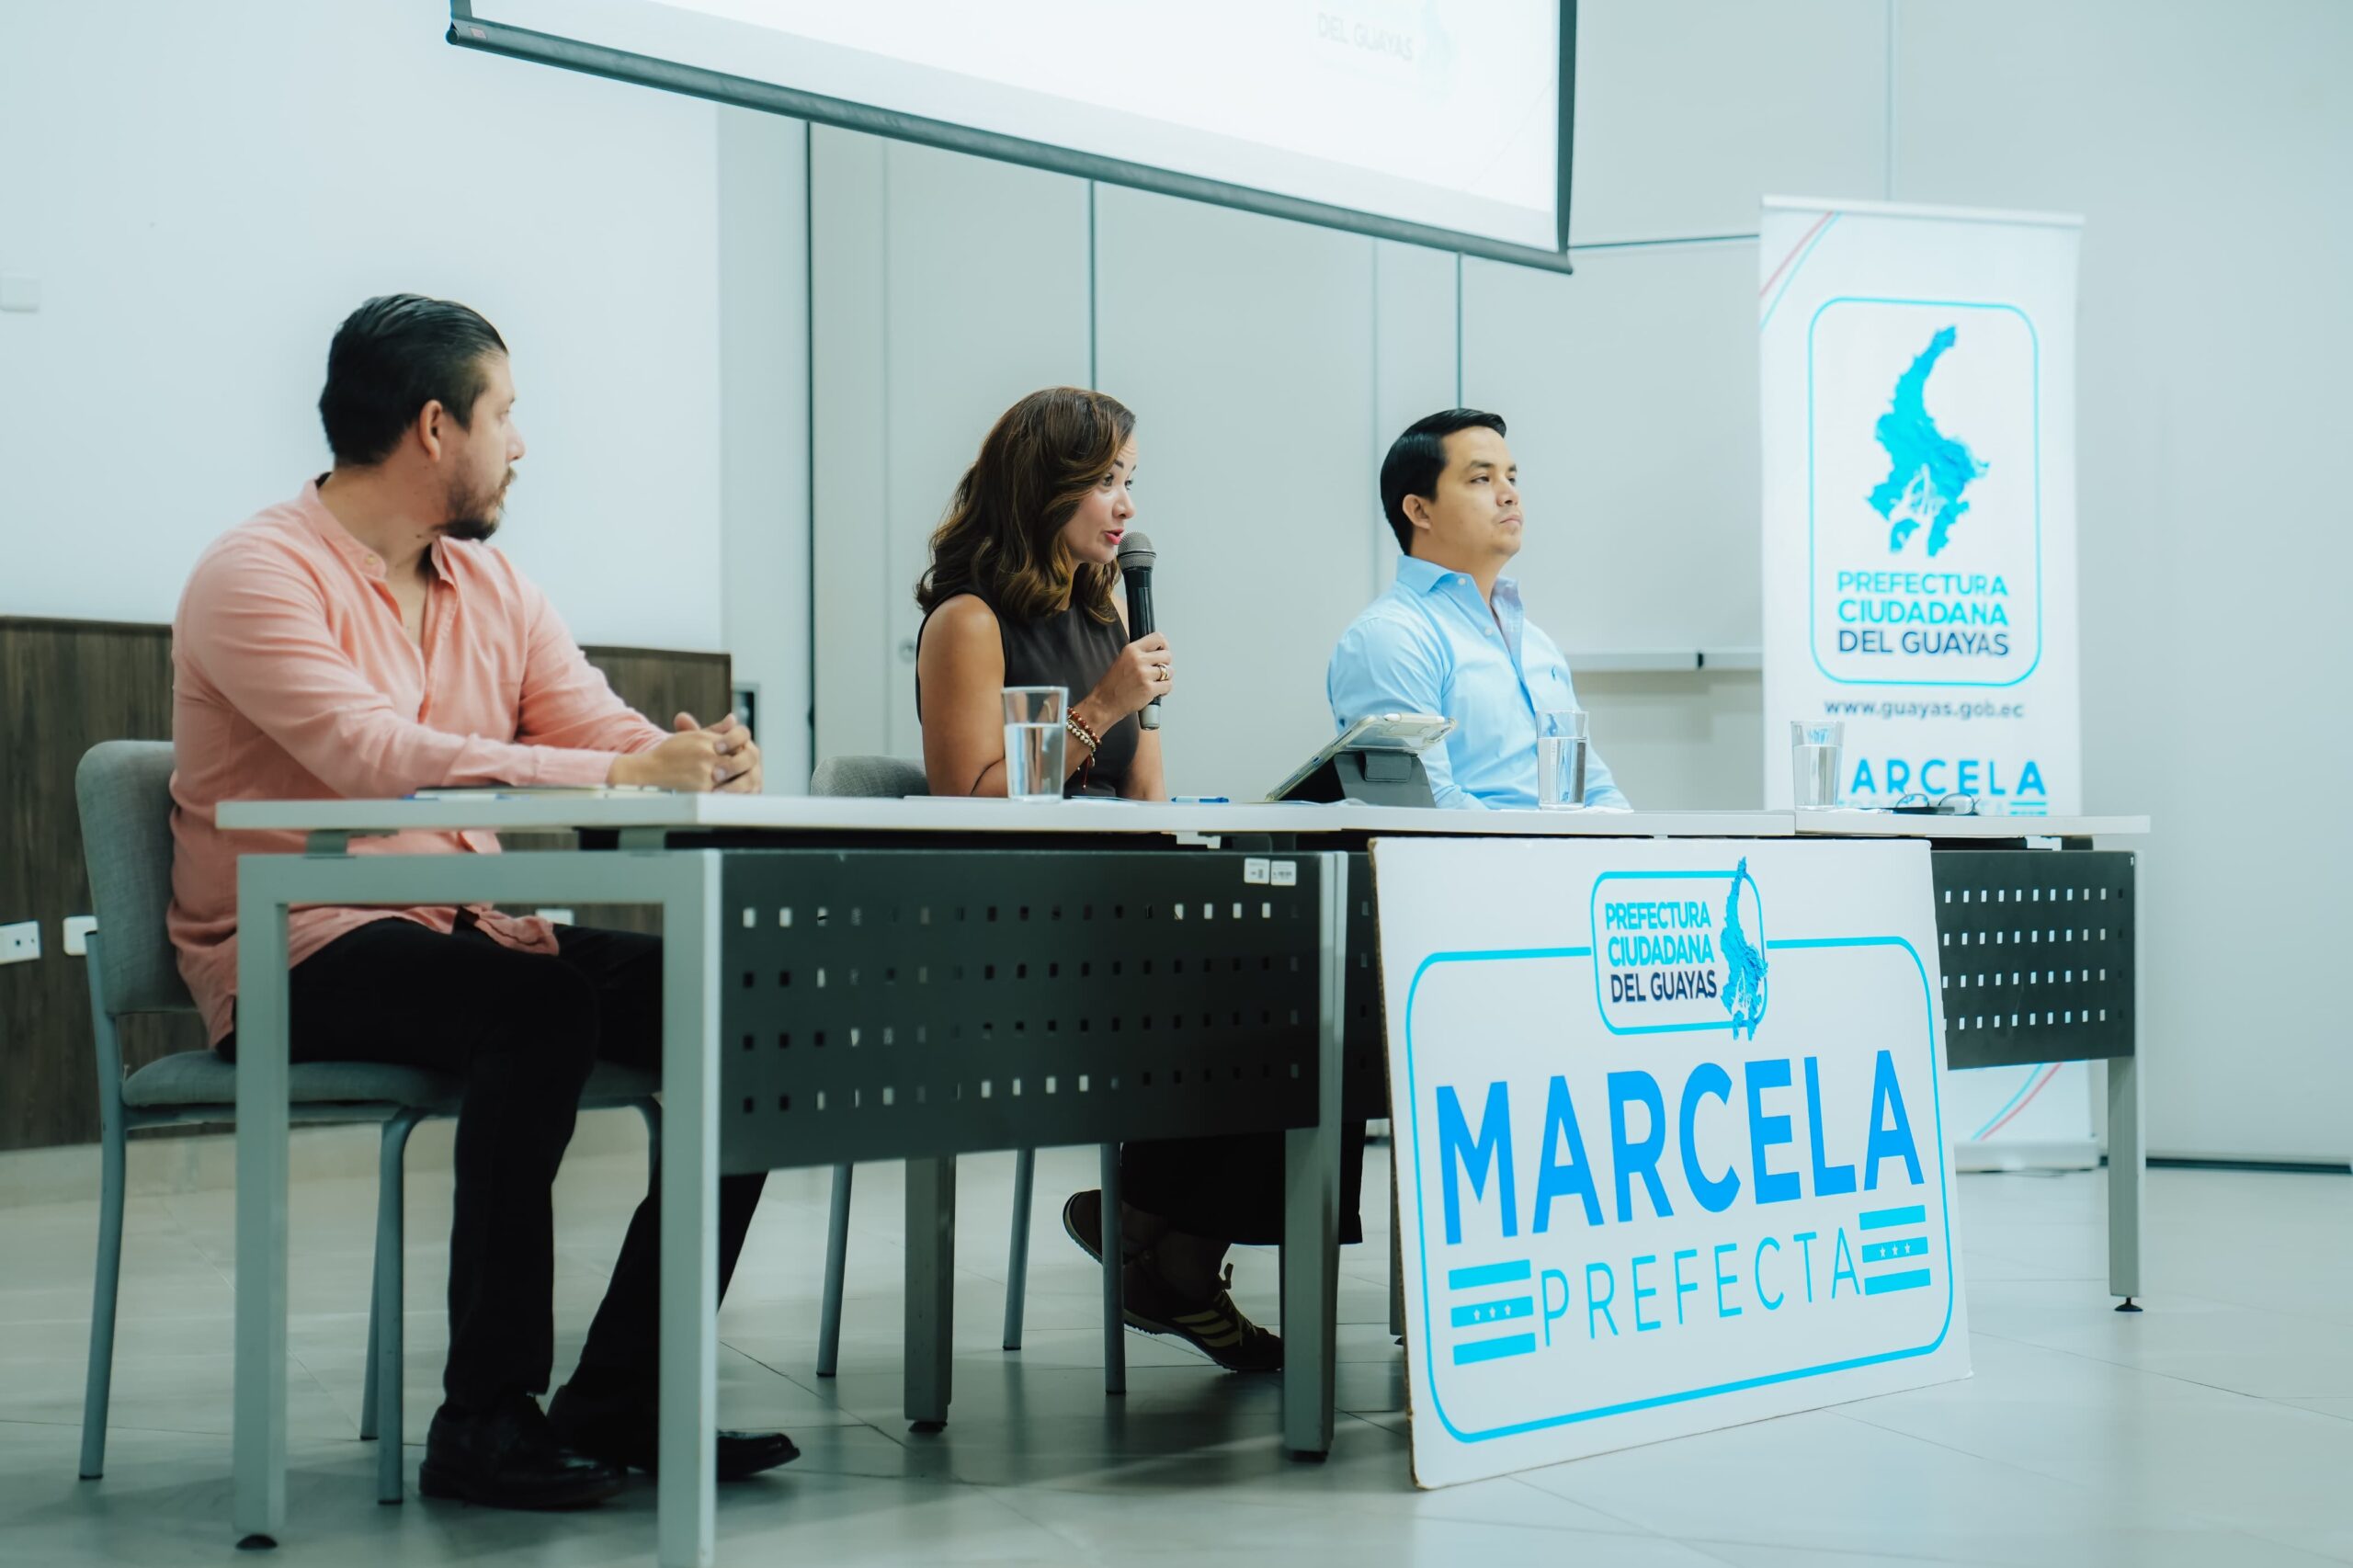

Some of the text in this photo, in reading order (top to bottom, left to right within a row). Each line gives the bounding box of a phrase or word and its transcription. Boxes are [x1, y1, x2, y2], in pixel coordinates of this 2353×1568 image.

[1317, 12, 1414, 62] DEL GUAYAS
[1836, 571, 2008, 597] PREFECTURA
[1838, 599, 2008, 626] CIUDADANA
[1838, 631, 2009, 655] DEL GUAYAS
[1824, 699, 2024, 720] www.guayas.gob.ec
[1850, 758, 2047, 797] ARCELA
[1605, 901, 1711, 930] PREFECTURA
[1608, 934, 1714, 967] CIUDADANA
[1610, 969, 1717, 1003] DEL GUAYAS
[1436, 1050, 1924, 1245] MARCELA
[1541, 1227, 1861, 1347] PREFECTA
